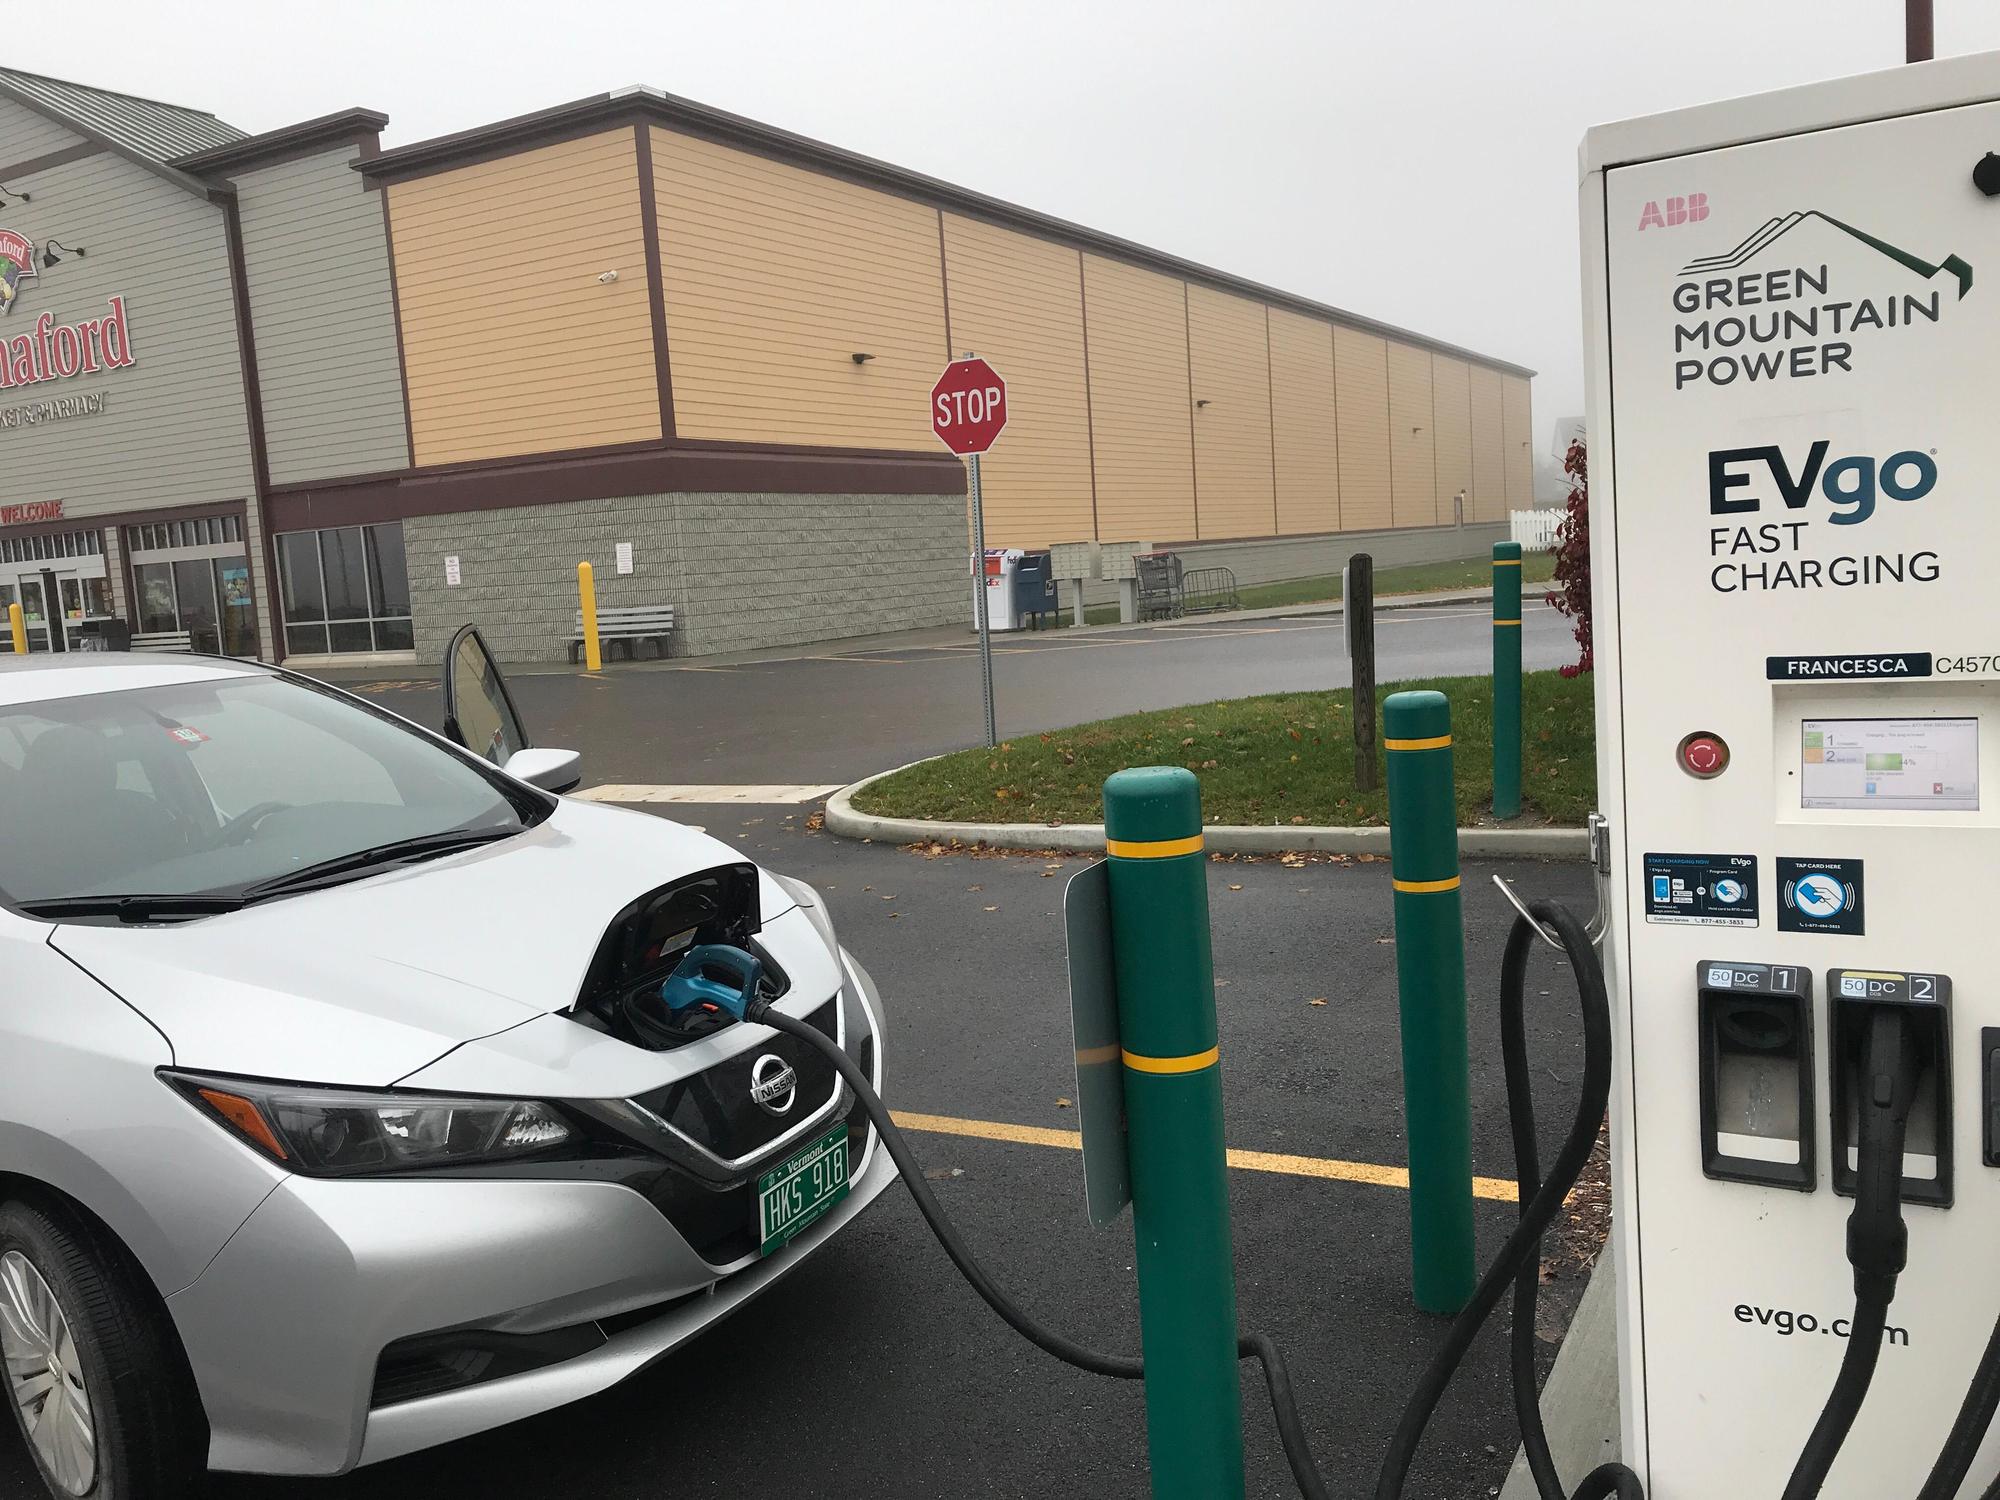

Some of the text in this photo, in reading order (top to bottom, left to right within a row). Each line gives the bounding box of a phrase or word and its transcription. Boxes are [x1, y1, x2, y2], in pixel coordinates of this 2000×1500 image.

[1638, 192, 1710, 231] ABB
[1673, 265, 1827, 313] GREEN
[1674, 291, 1939, 352] MOUNTAIN
[1676, 342, 1852, 390] POWER
[37, 393, 105, 421] PHARMACY
[936, 387, 1001, 427] STOP
[1708, 440, 1937, 525] EVgo
[1, 501, 63, 525] WELCOME
[1710, 522, 1809, 556] FAST
[1711, 551, 1940, 592] CHARGING
[1787, 658, 1908, 675] FRANCESCA
[1826, 734, 1834, 746] 1
[1826, 751, 1836, 762] 2
[1730, 858, 1752, 867] EVgo
[1711, 971, 1730, 982] 50
[1734, 972, 1759, 984] DC
[1778, 970, 1789, 989] 1
[1844, 980, 1864, 990] 50
[1869, 981, 1896, 993] DC
[1914, 978, 1932, 999] 2
[761, 1072, 797, 1099] NISSAN
[787, 1142, 823, 1173] Vermont
[770, 1148, 843, 1231] HKS 918
[1735, 1303, 1909, 1346] evgo.cm
